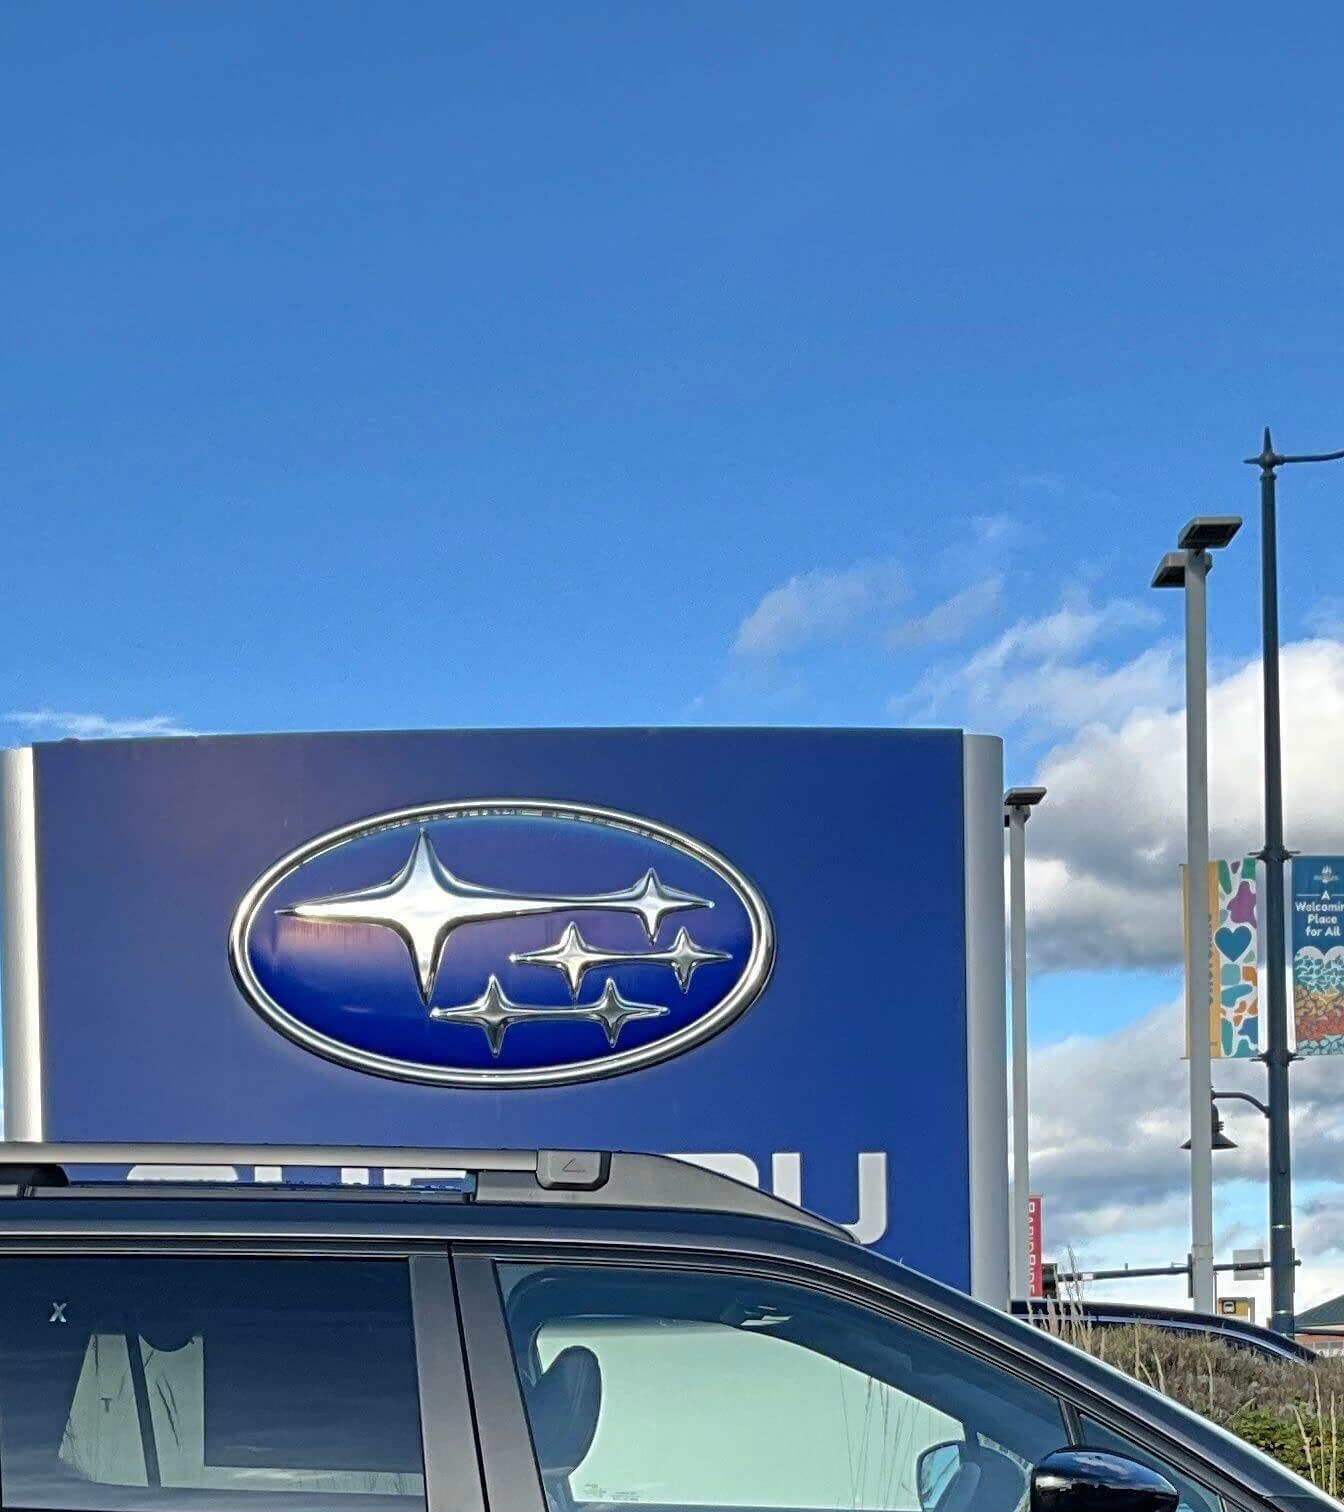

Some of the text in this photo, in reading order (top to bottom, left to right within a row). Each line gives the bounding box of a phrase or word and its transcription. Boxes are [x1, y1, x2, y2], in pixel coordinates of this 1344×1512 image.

[1321, 890, 1331, 900] A
[1307, 913, 1338, 924] Place
[1305, 926, 1341, 936] for All
[49, 1302, 67, 1323] X
